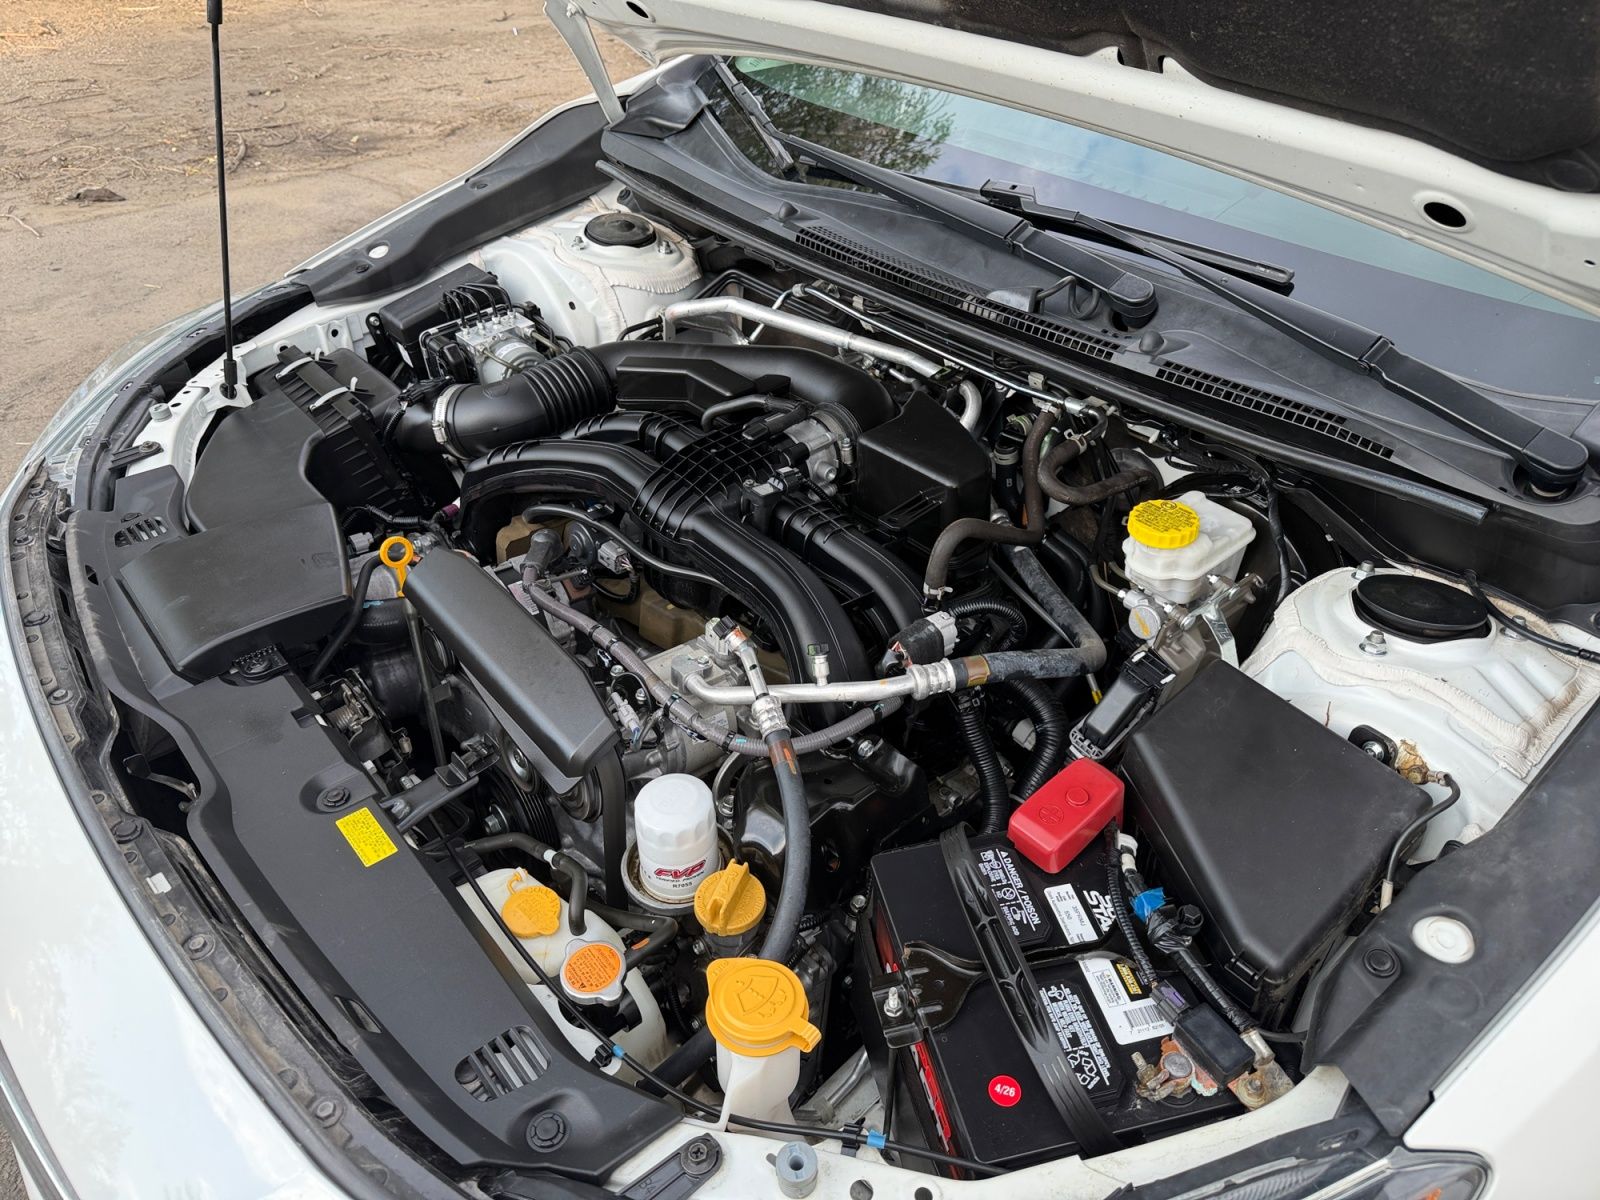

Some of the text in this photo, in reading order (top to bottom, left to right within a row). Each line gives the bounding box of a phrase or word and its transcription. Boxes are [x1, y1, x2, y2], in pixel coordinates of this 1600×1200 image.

[654, 859, 707, 880] FVP
[1004, 858, 1024, 890] DANGER
[1021, 895, 1041, 925] POISON
[1011, 925, 1020, 936] ACID
[994, 1083, 1015, 1097] 4/26
